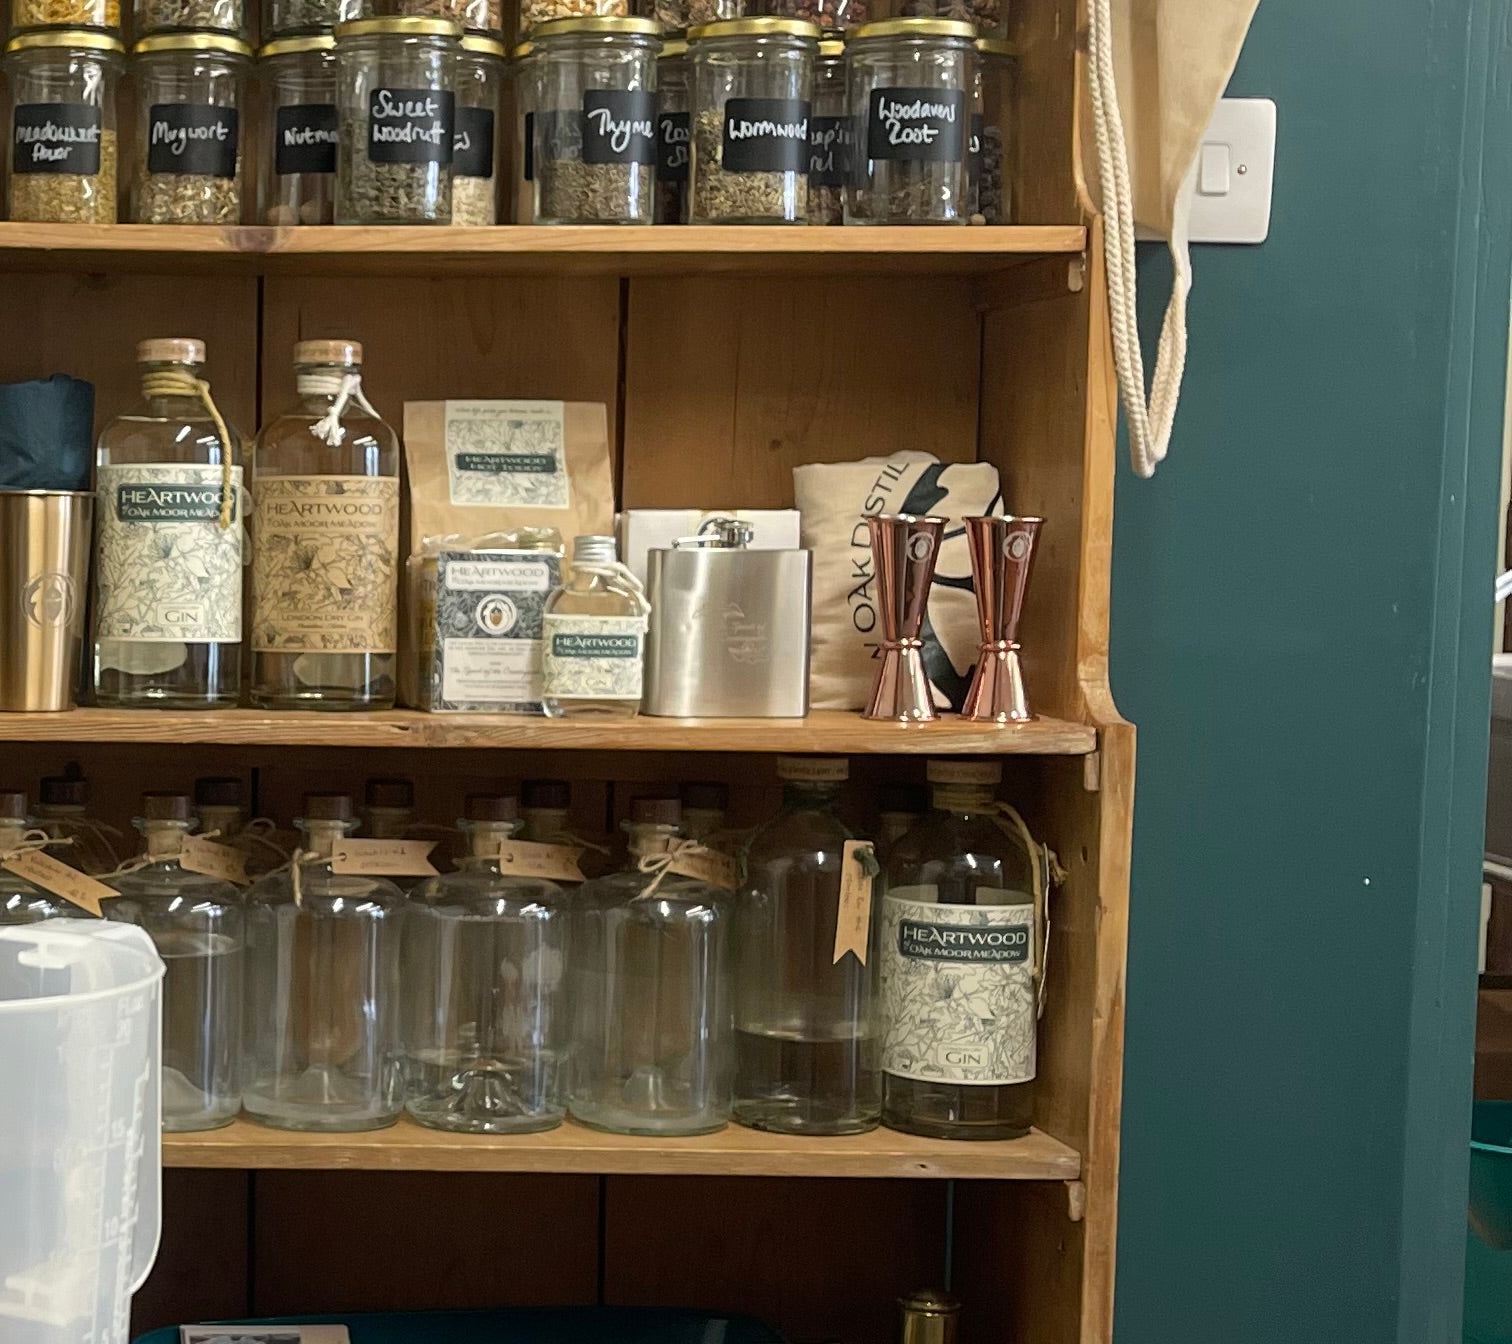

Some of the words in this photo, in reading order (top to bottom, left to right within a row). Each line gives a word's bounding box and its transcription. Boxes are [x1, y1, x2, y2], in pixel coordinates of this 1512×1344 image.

[373, 90, 439, 119] Sweet
[151, 120, 229, 156] Mugwort
[588, 108, 654, 154] Thyme
[885, 119, 939, 146] Root
[128, 508, 152, 519] OAK
[154, 508, 189, 519] MOOR
[266, 501, 383, 521] HEARTWOOD
[451, 566, 545, 578] HEARTWOOD
[847, 556, 876, 633] OAK
[164, 609, 198, 624] GIN
[281, 613, 320, 623] LONDON
[347, 613, 363, 622] GIN
[556, 637, 637, 648] HEARTWOOD
[903, 925, 1027, 947] HEARTWOOD
[908, 945, 932, 957] OAK
[934, 946, 973, 959] MOOR
[945, 1050, 982, 1066] GIN
